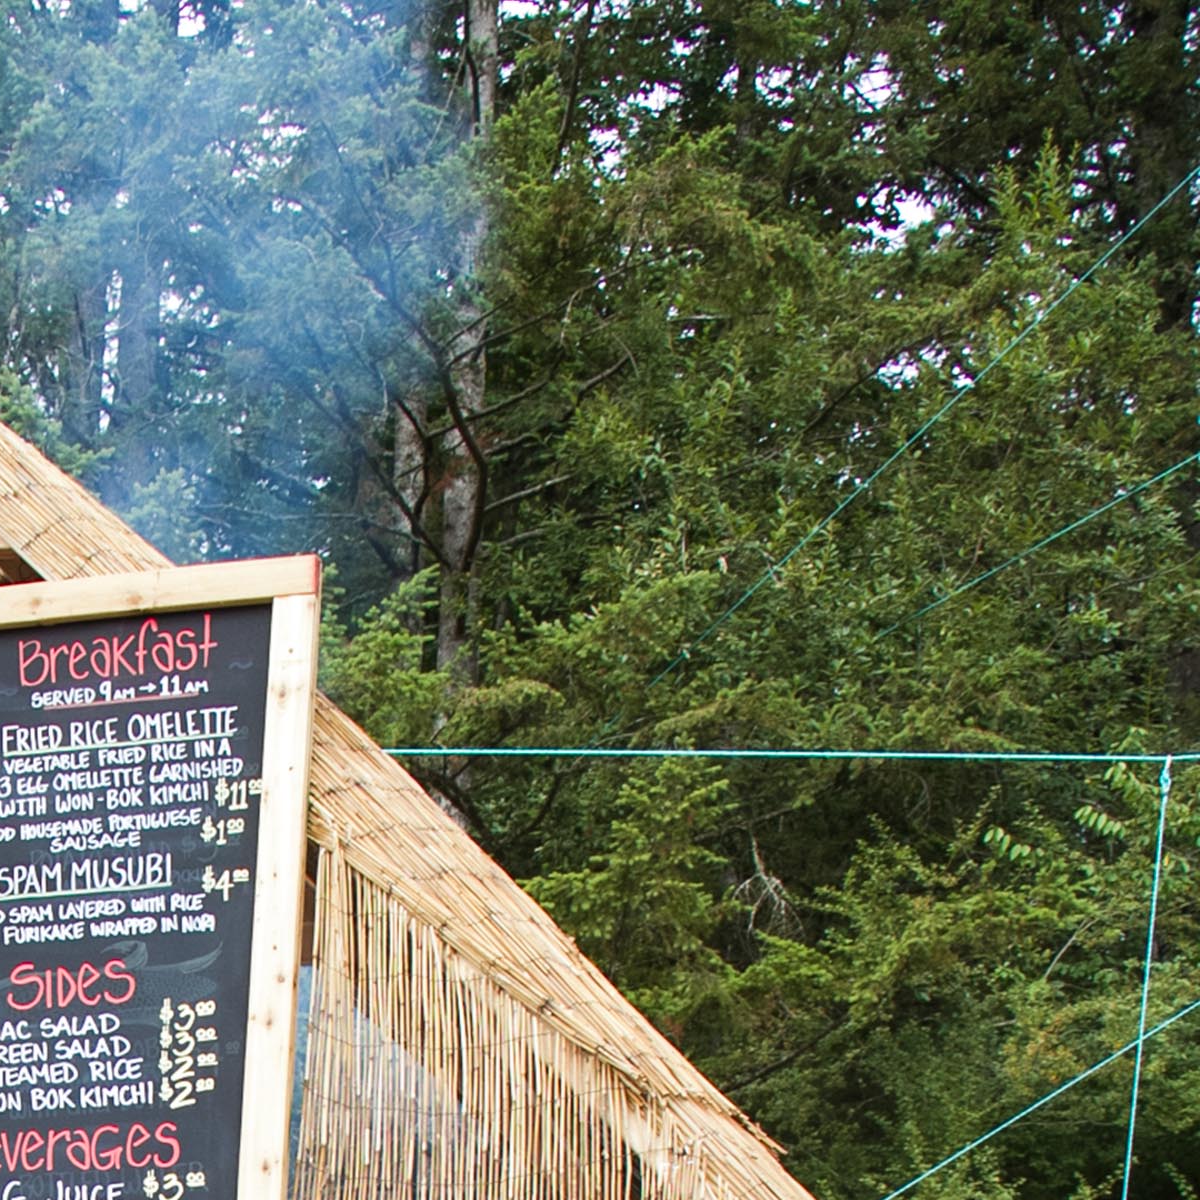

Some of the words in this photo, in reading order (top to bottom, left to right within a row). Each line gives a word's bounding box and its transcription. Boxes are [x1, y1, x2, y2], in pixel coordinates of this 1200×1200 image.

[18, 613, 218, 686] Breakfast
[31, 687, 96, 708] SERVED
[2, 725, 62, 753] FRIED
[70, 717, 118, 748] RICE
[127, 706, 238, 742] OMELETTE
[98, 750, 146, 766] FRIED
[151, 742, 187, 761] RICE
[194, 740, 215, 758] IN
[218, 738, 232, 756] A
[16, 777, 48, 795] EGG
[150, 758, 244, 781] GARNISHED
[150, 780, 209, 804] KIMCHI
[20, 818, 103, 840] HOUSEMADE
[108, 808, 202, 831] PORTUGUESE
[50, 832, 142, 852] SAUSAGE
[70, 853, 172, 890] MUSUBI
[9, 905, 53, 922] SPAM
[59, 899, 126, 920] LAYERED
[131, 896, 166, 912] WITH
[170, 893, 206, 912] RICE
[3, 922, 84, 944] FURIKAKE
[90, 917, 157, 936] WRAPPED
[161, 914, 178, 932] IN
[181, 914, 215, 932] NORI
[40, 1013, 121, 1038] SALAD
[54, 1036, 132, 1060] SALAD
[90, 1057, 144, 1082] RICE
[30, 1088, 75, 1110] BOK
[80, 1081, 154, 1106] KIMCHI
